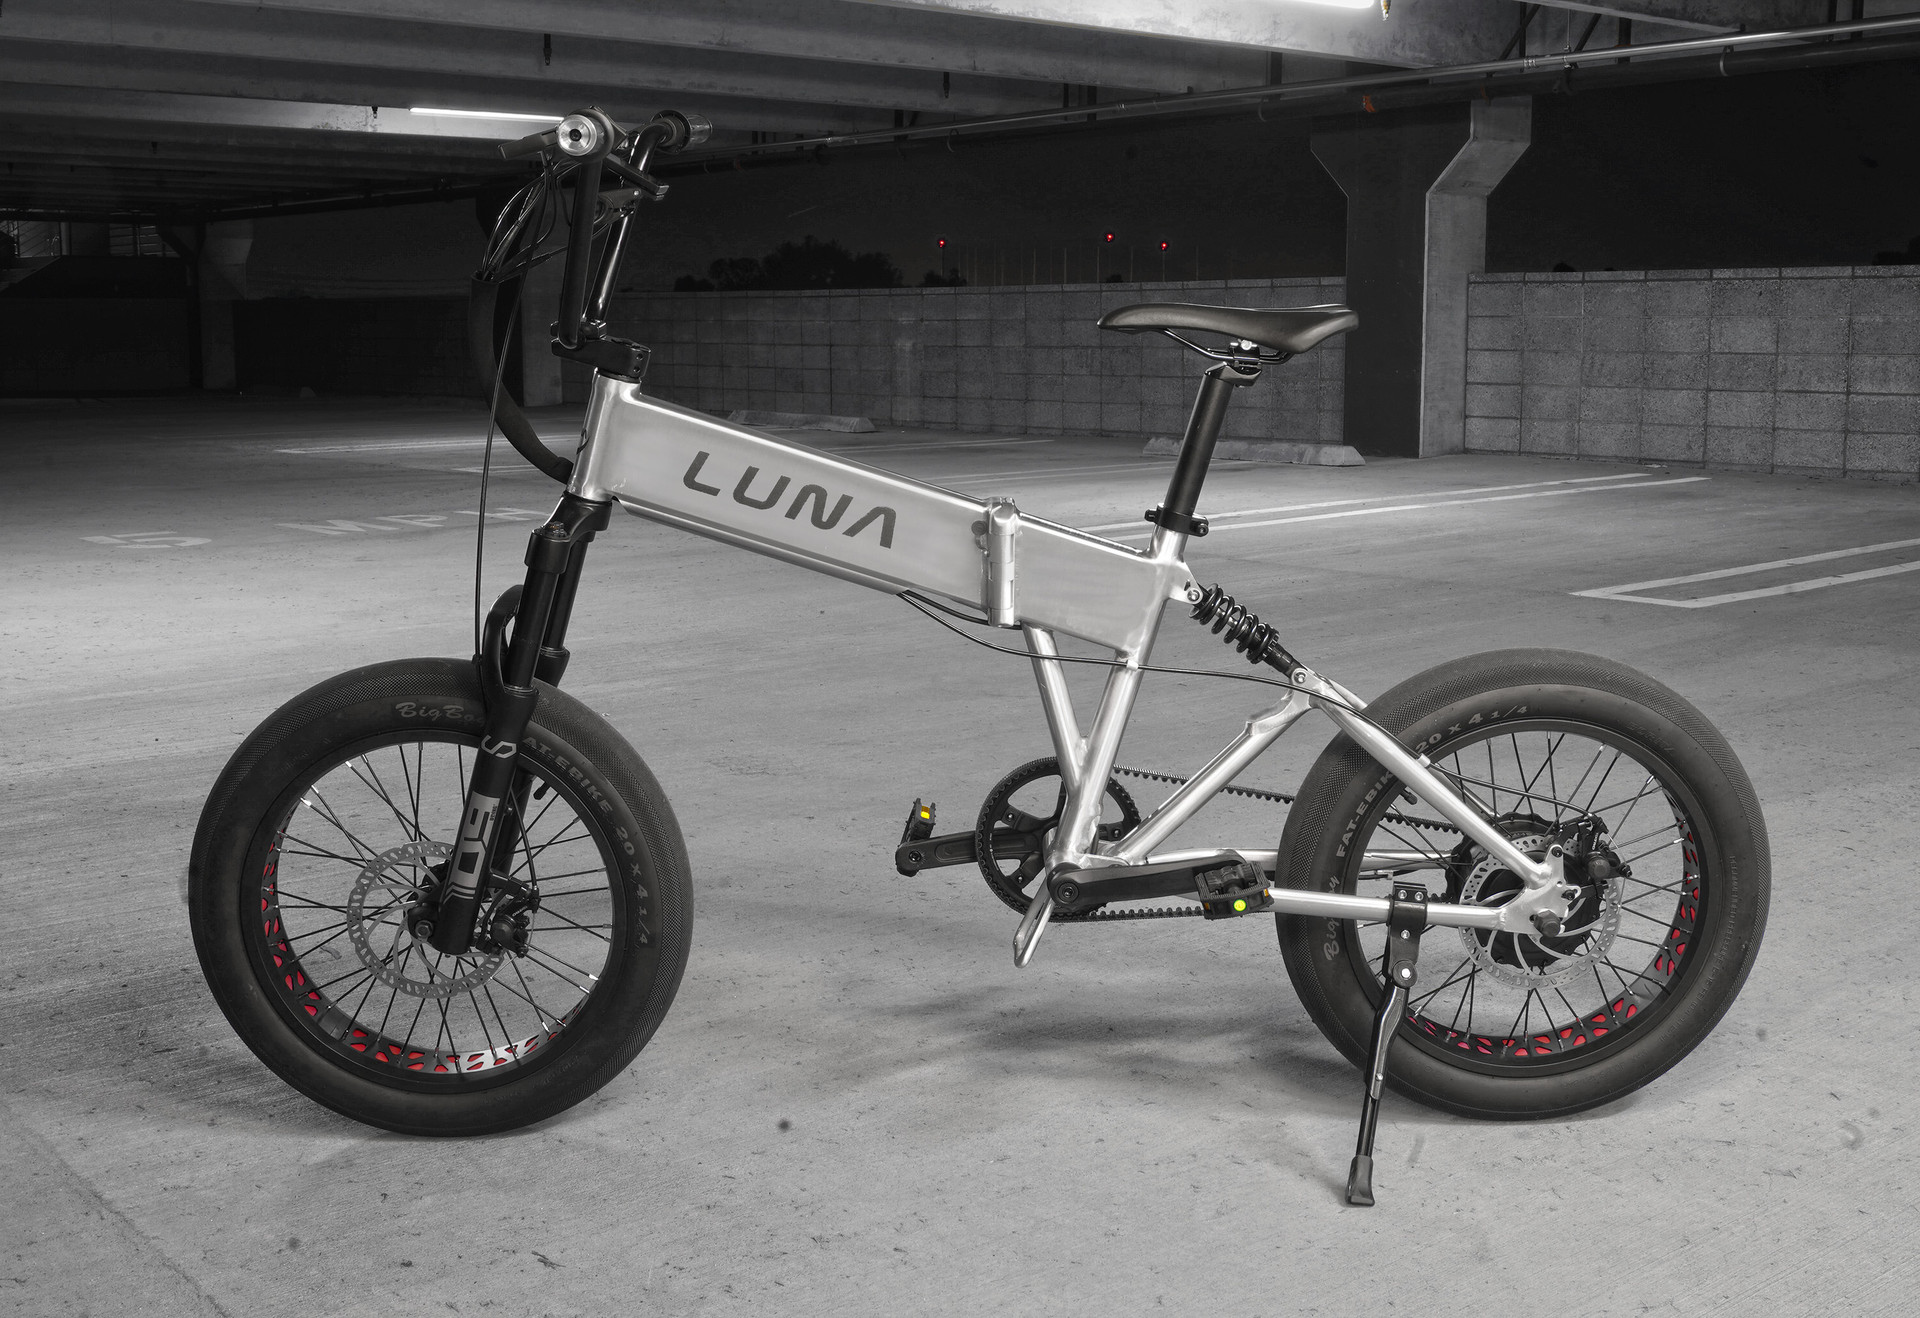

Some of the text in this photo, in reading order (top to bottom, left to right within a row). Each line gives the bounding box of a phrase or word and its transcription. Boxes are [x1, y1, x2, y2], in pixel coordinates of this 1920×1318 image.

[79, 507, 550, 549] 5 MPH
[683, 450, 897, 549] LUNA
[522, 736, 613, 813] AT-EBIKE
[614, 826, 635, 856] 20
[636, 885, 649, 900] 4
[1336, 770, 1394, 858] FAT-EBIK
[1415, 733, 1442, 753] 20
[1468, 713, 1483, 724] 4
